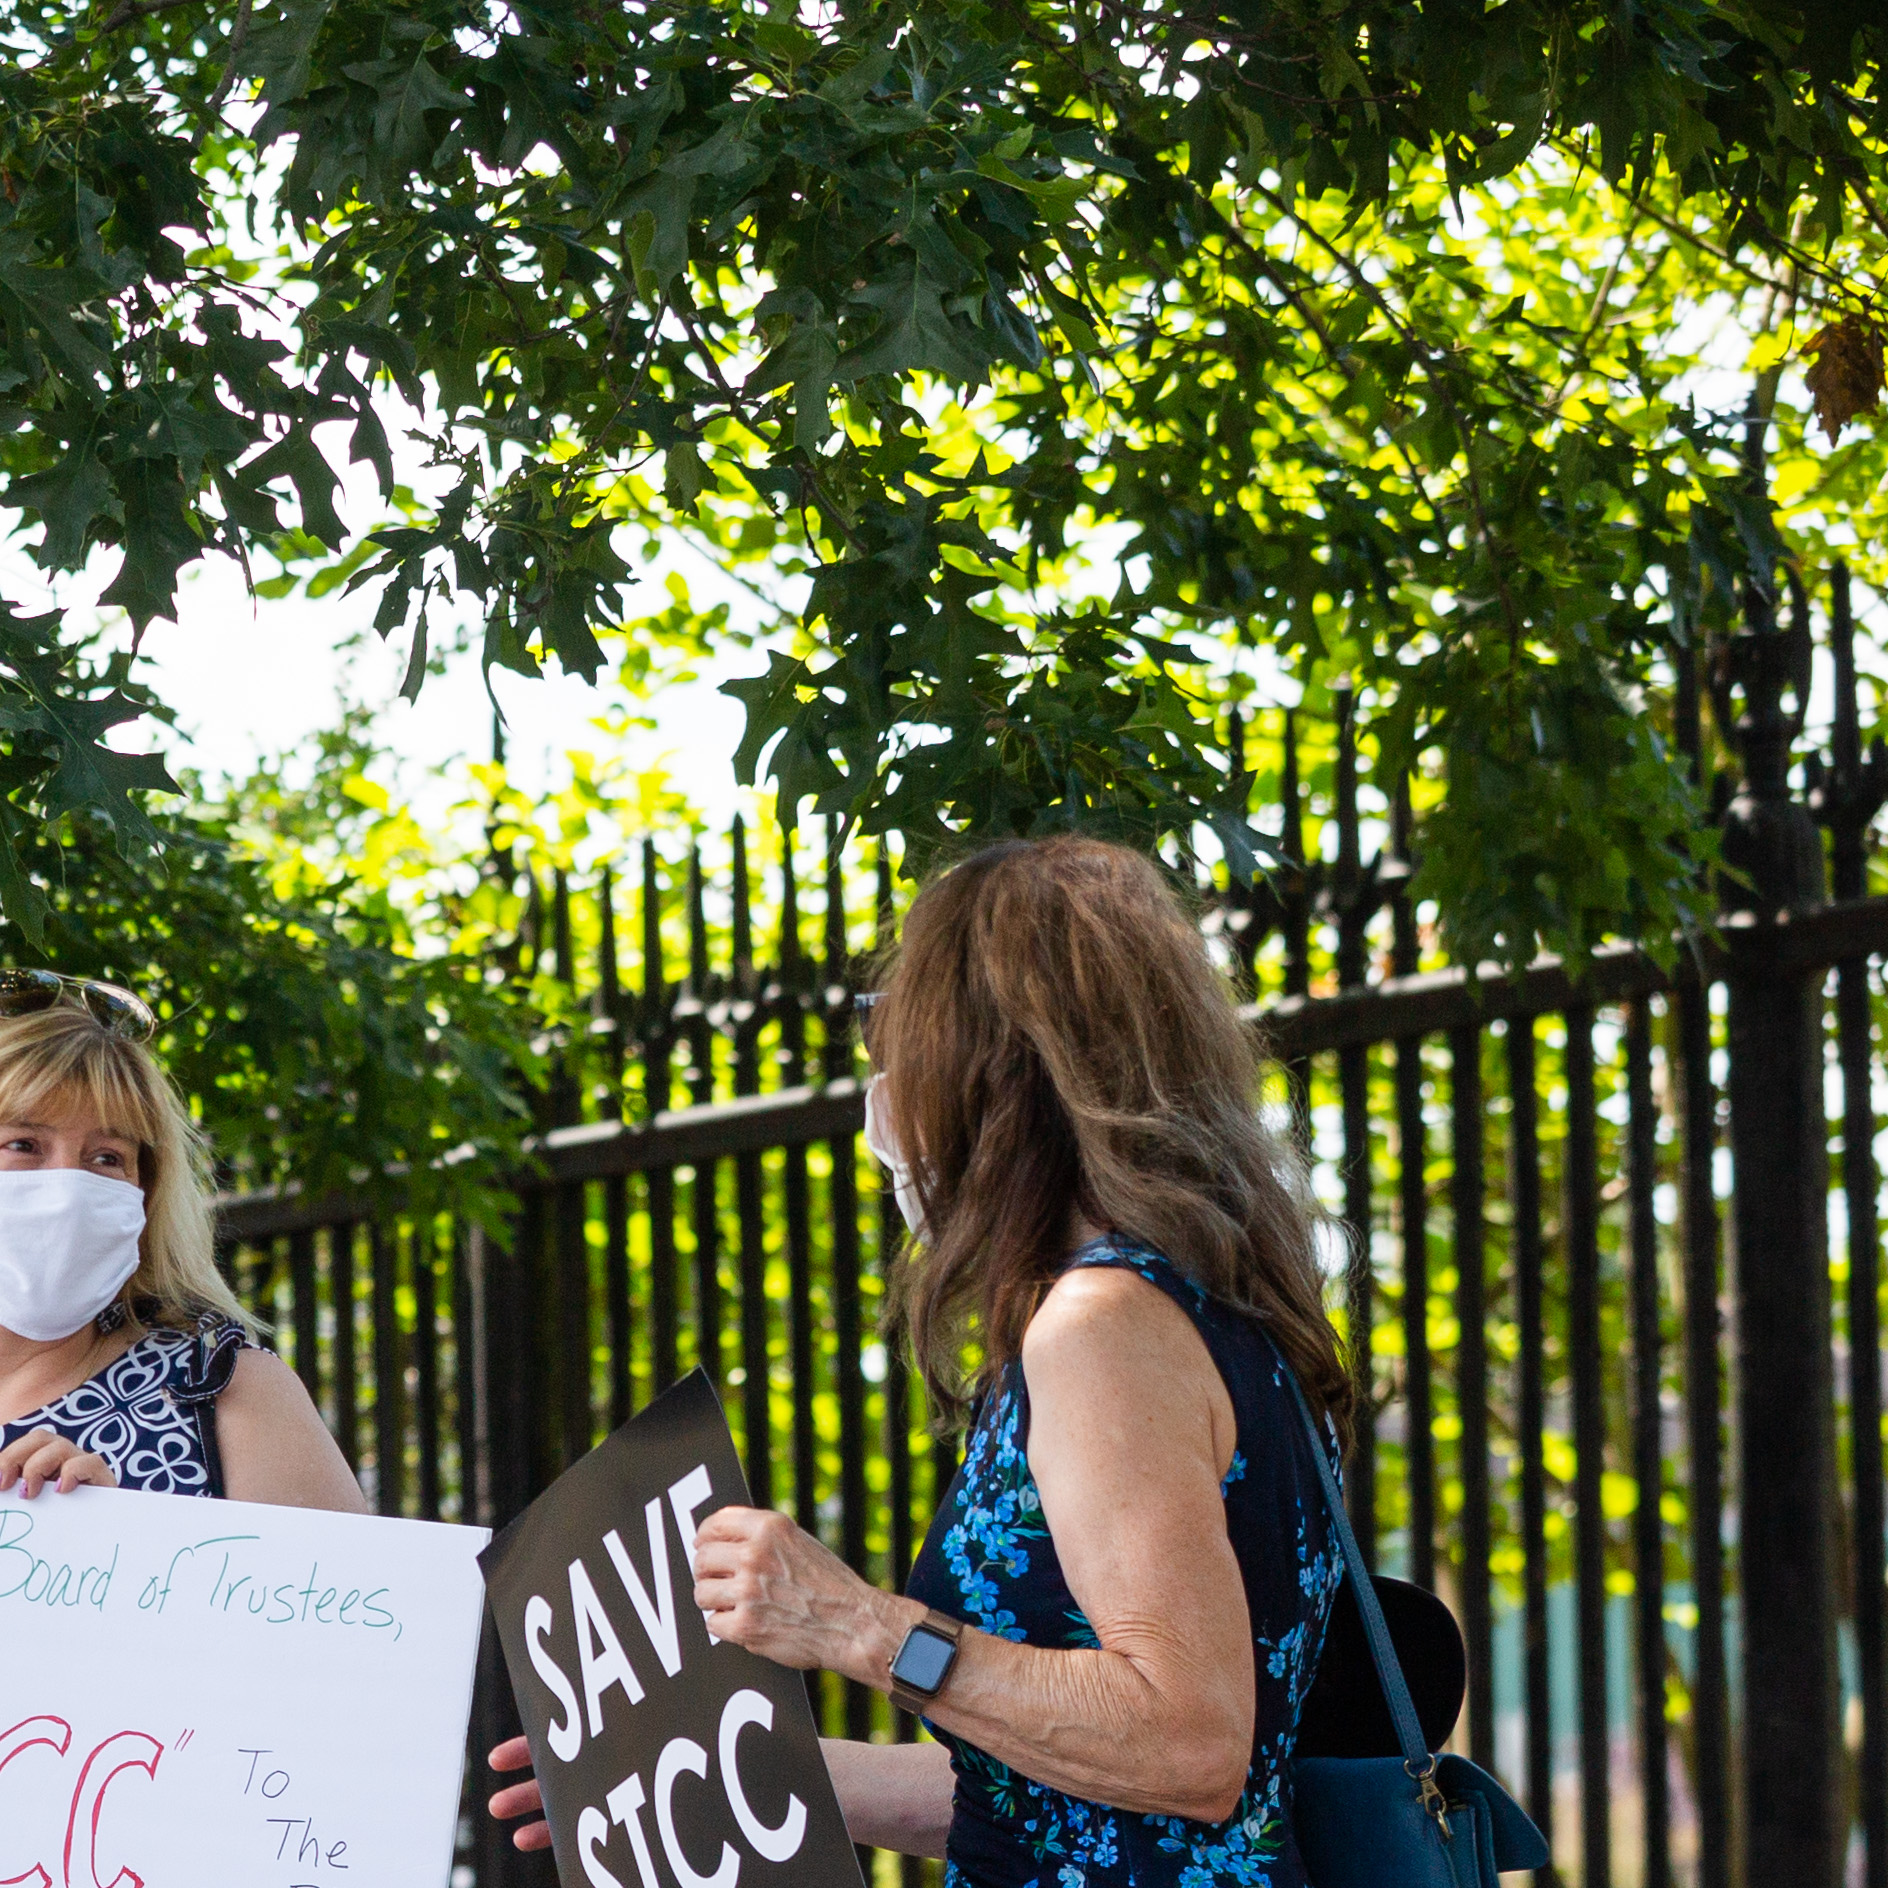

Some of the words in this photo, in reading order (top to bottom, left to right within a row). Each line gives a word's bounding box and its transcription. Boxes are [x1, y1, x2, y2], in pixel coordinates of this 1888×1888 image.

[138, 1546, 195, 1615] of
[193, 1534, 403, 1643] Trustees,
[237, 1748, 291, 1799] To
[266, 1816, 350, 1869] The
